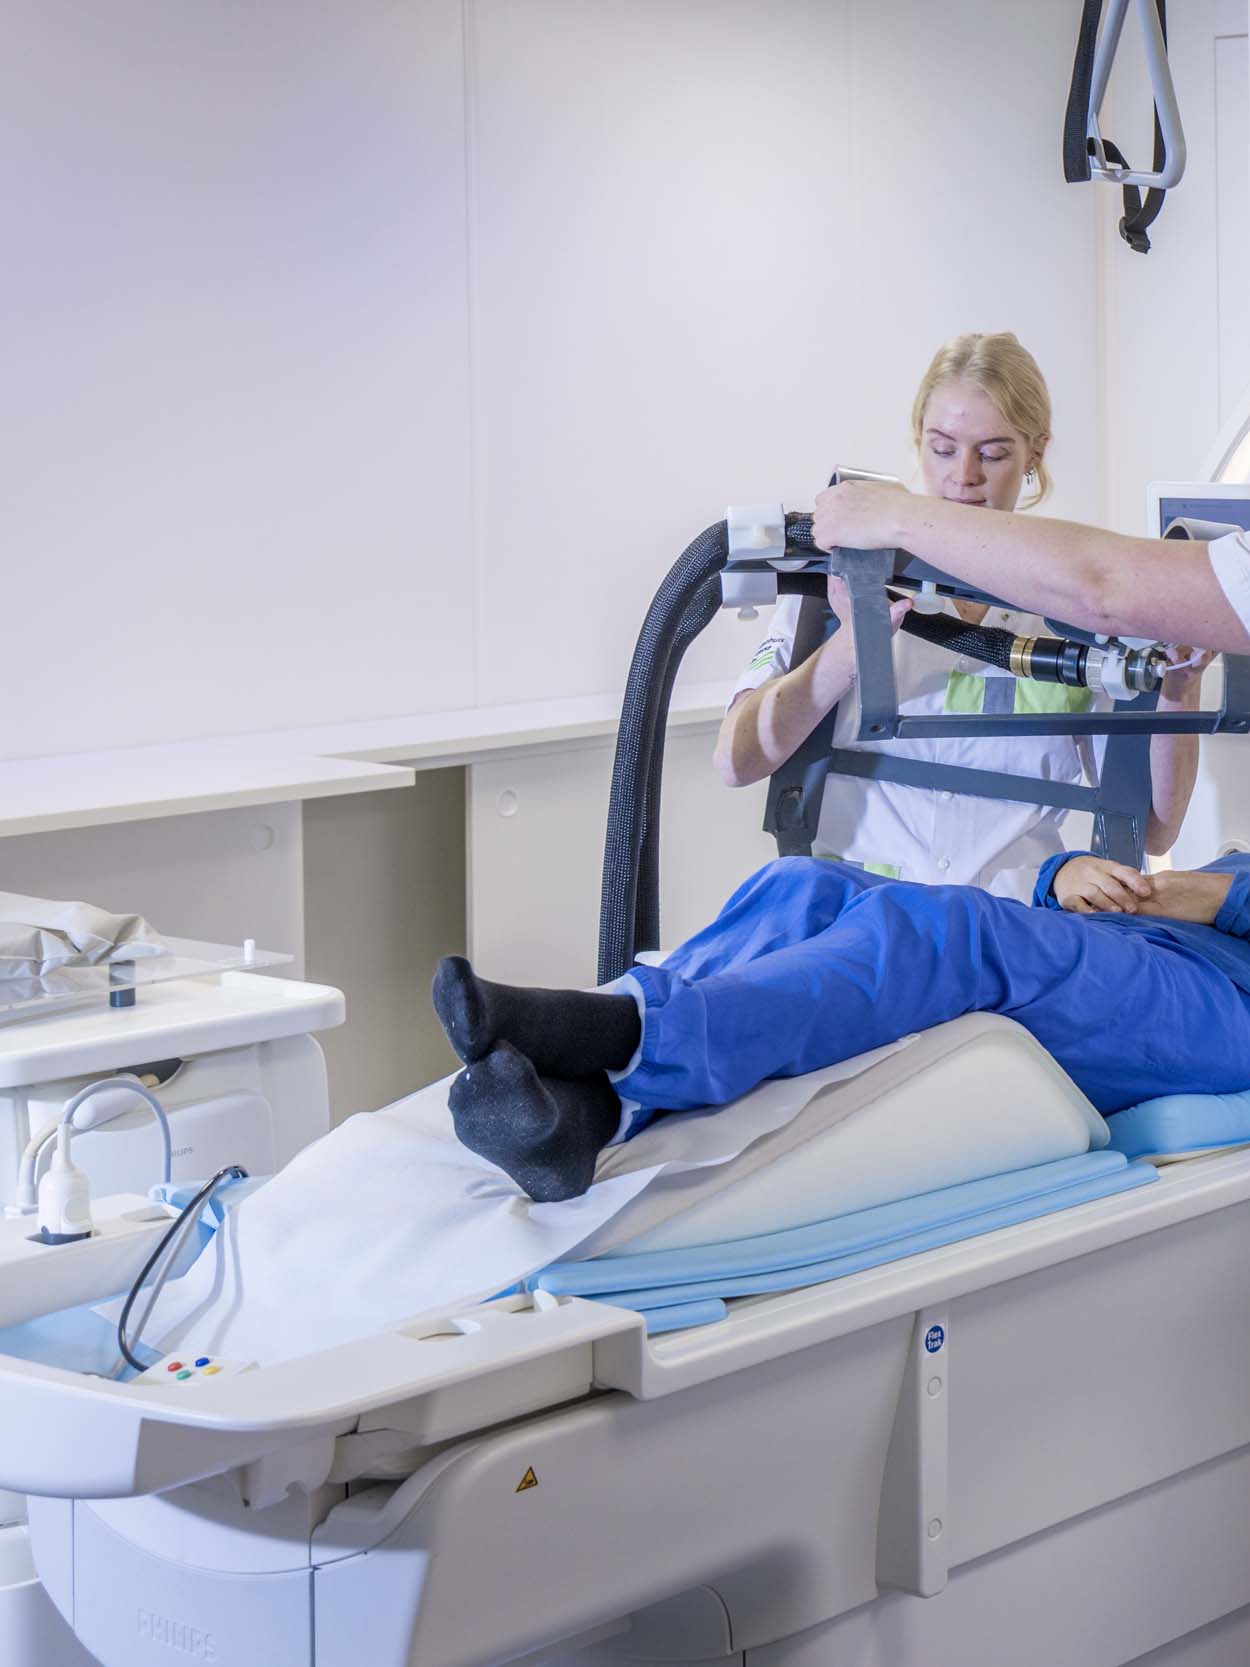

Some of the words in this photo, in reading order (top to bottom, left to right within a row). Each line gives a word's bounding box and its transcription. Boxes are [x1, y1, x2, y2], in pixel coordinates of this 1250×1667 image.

[927, 1331, 942, 1340] Flex
[927, 1339, 942, 1350] Trak
[136, 1607, 216, 1660] PHILIPS
